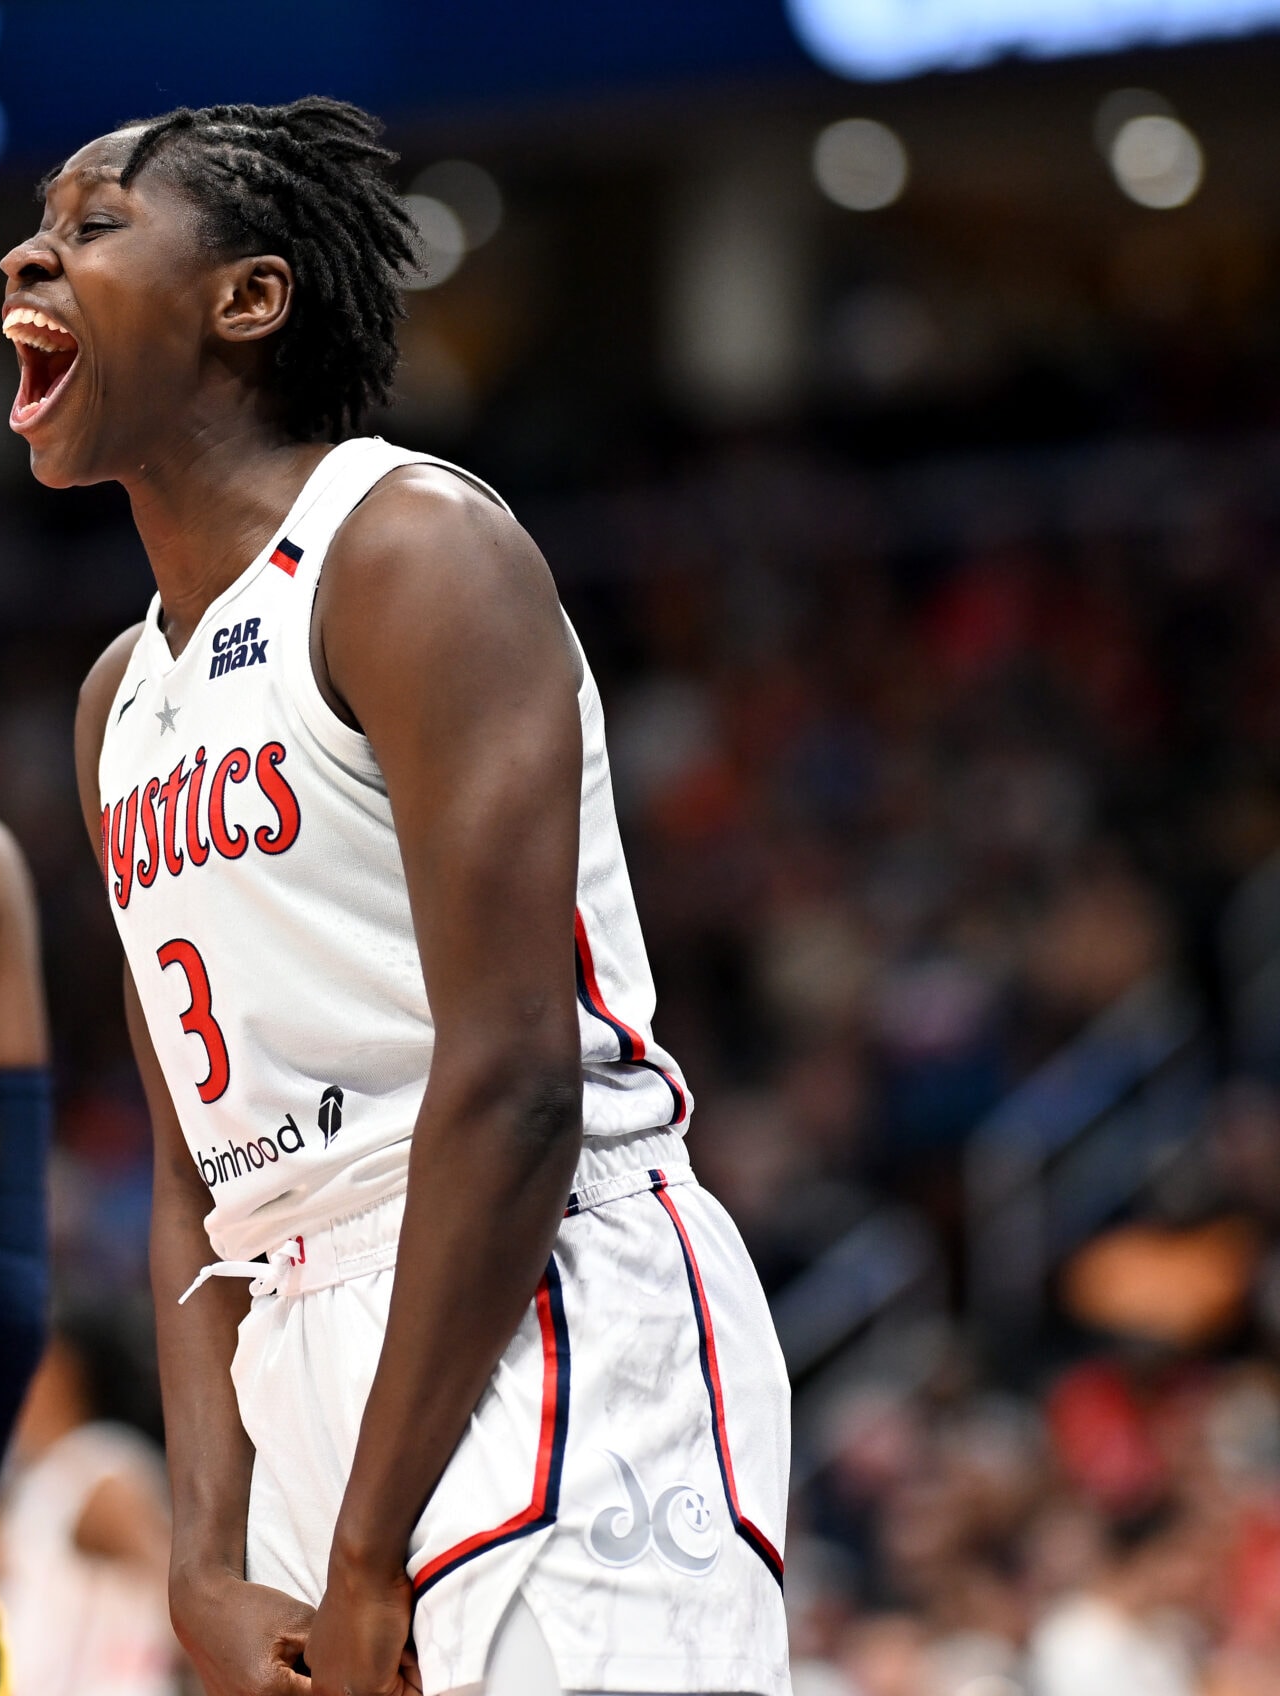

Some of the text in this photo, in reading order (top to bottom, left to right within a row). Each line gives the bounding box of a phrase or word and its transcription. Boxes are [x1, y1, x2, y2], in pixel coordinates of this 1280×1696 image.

[213, 617, 261, 653] CAR
[209, 640, 269, 680] max
[156, 938, 230, 1104] 3
